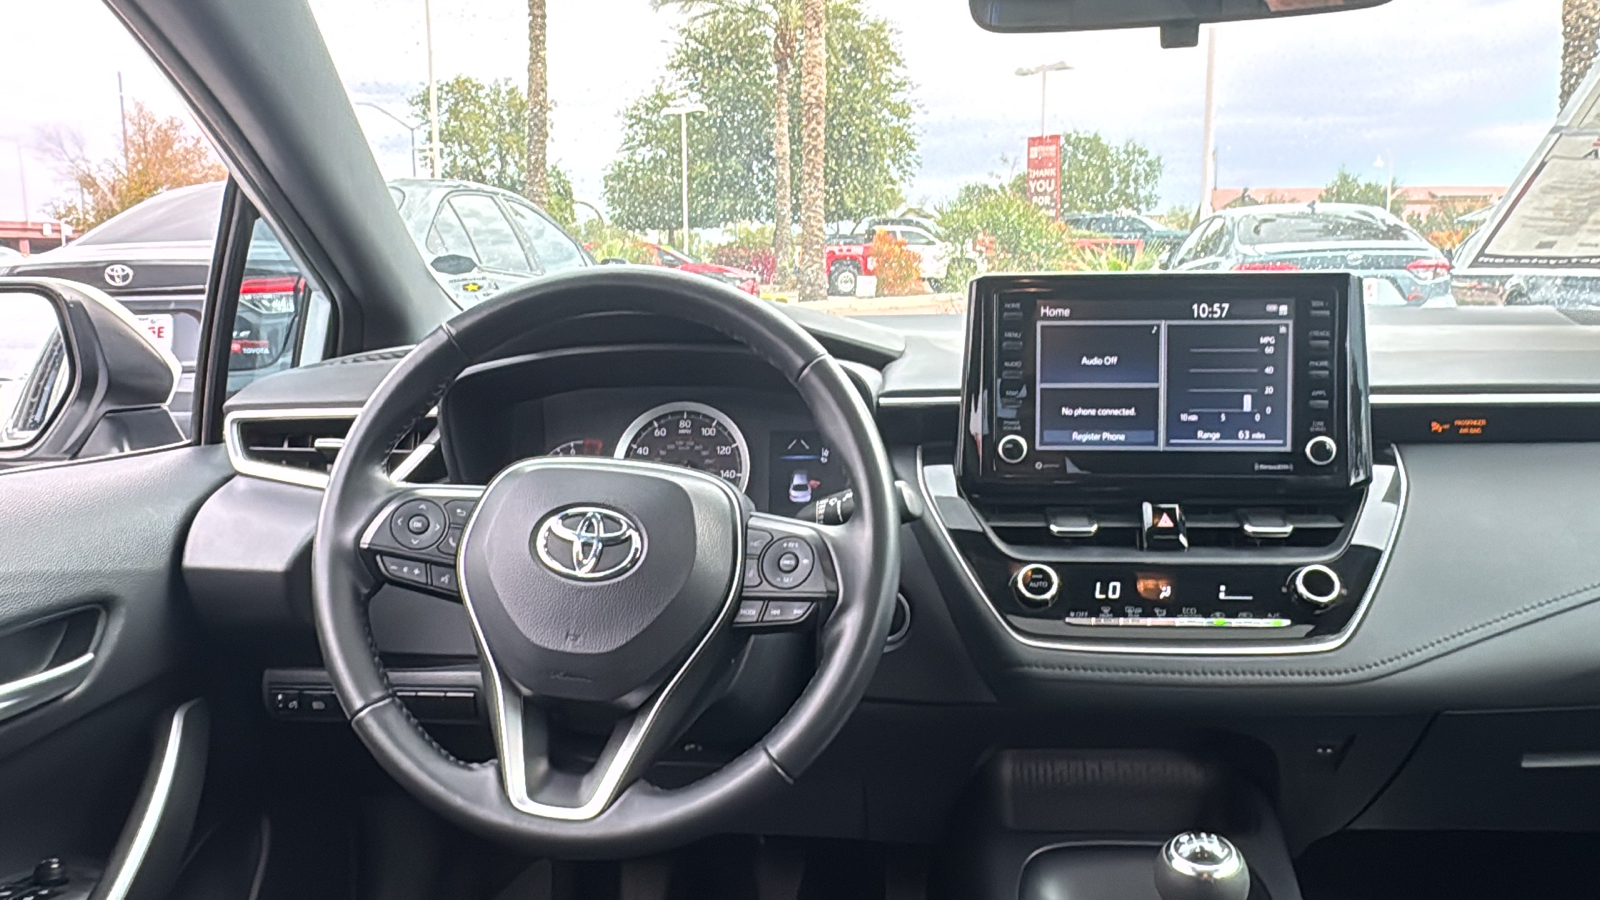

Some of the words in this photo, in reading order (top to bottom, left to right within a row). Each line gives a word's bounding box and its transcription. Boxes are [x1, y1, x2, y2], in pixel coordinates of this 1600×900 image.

[1029, 168, 1056, 178] THANK
[1029, 179, 1055, 193] YOU
[1040, 306, 1071, 317] Home
[1191, 303, 1230, 318] 10:57
[1260, 336, 1275, 344] MPG
[1264, 346, 1274, 354] 60
[1081, 356, 1103, 365] Audio
[1104, 356, 1118, 365] Off
[1264, 366, 1274, 374] 40
[1264, 386, 1274, 395] 20
[1061, 407, 1073, 415] No
[1074, 407, 1096, 417] phone
[1097, 407, 1137, 416] connected.
[1265, 406, 1272, 415] 0
[1254, 413, 1261, 422] 0
[679, 420, 692, 429] 80
[654, 427, 667, 437] 60
[701, 427, 716, 437] 100
[1072, 431, 1101, 442] Register
[1102, 431, 1125, 441] Phone
[1197, 430, 1221, 441] Range
[1238, 430, 1250, 440] 63
[637, 446, 649, 456] 40
[716, 446, 732, 455] 120
[720, 469, 736, 479] 140
[1029, 580, 1048, 588] AUTO
[1095, 581, 1121, 599] LO
[1182, 606, 1198, 615] ECO
